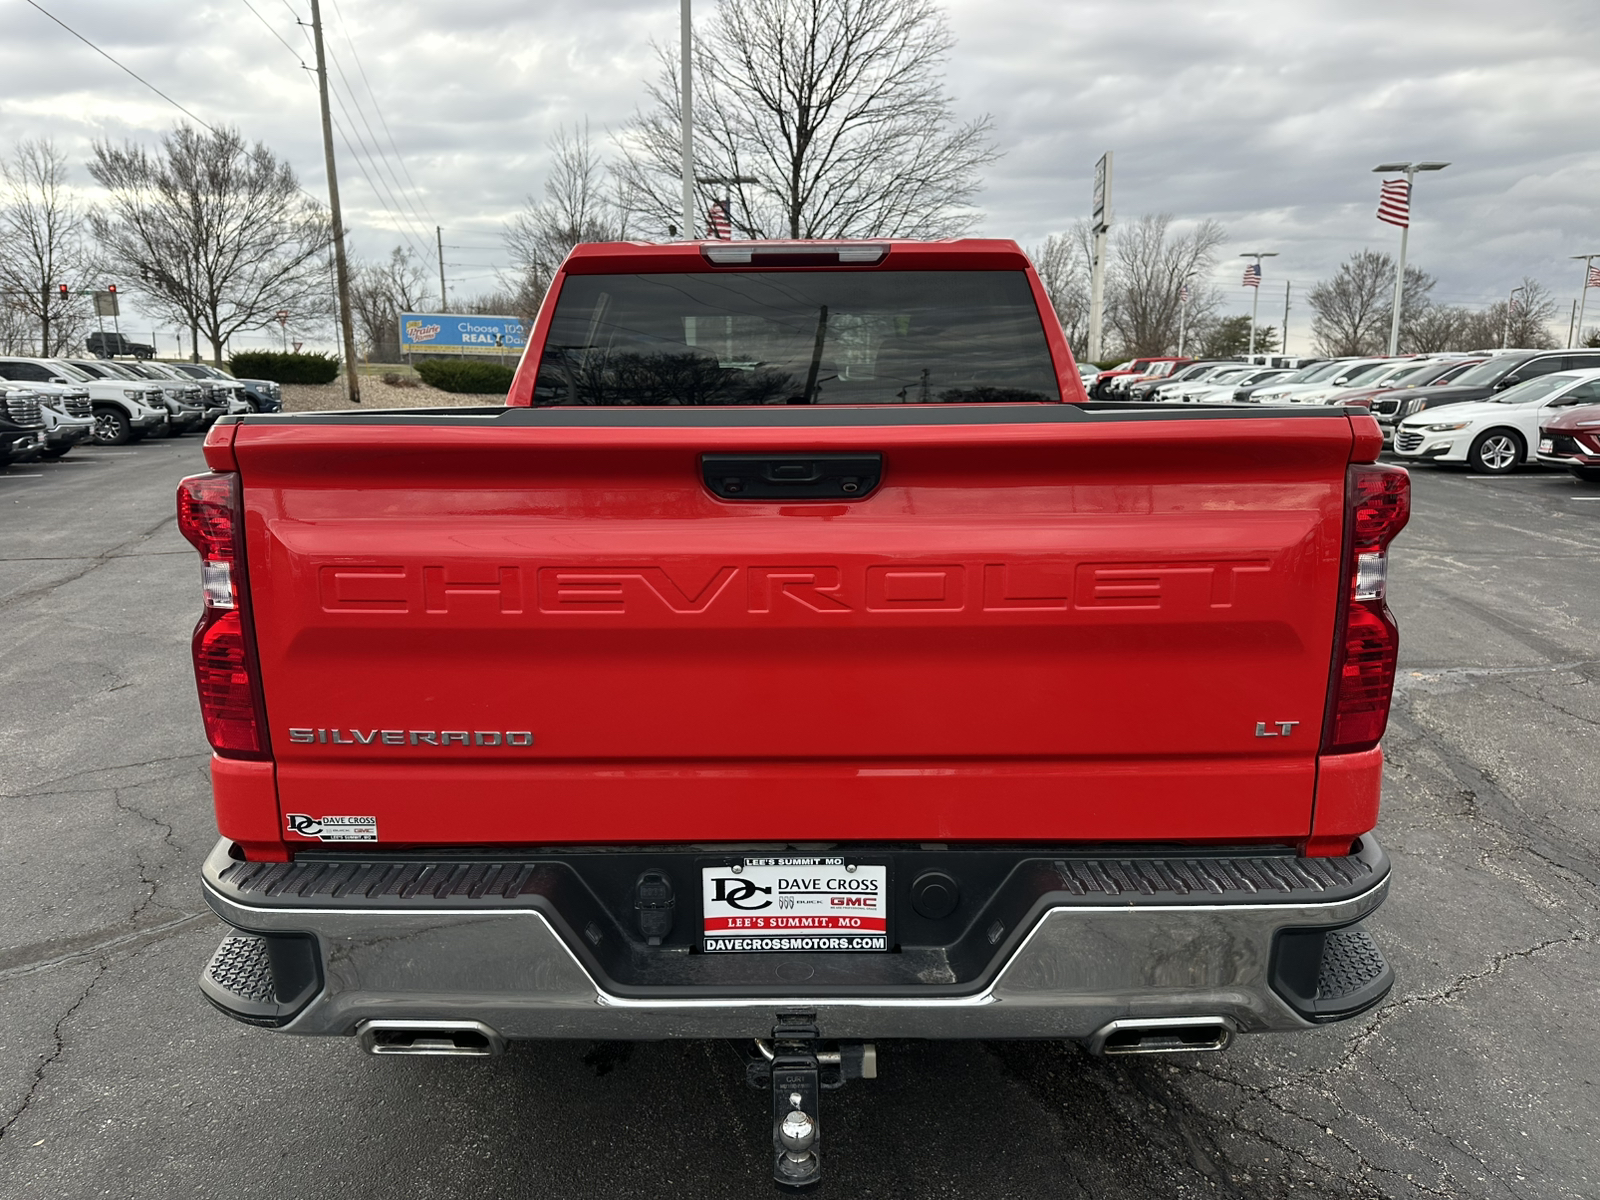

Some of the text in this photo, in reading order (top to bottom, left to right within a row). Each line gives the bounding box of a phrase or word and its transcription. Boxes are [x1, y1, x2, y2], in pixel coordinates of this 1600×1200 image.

[408, 324, 440, 337] Prairie
[458, 323, 498, 332] Choose
[462, 333, 493, 343] REAL
[318, 558, 1270, 615] CHEVROLET
[1255, 721, 1300, 737] LT
[289, 728, 534, 746] SILVERADO
[746, 858, 776, 866] LEE'S
[778, 858, 820, 866] SUMMIT
[778, 879, 878, 891] DAVE CROSS
[830, 897, 877, 907] GMC
[728, 918, 861, 928] LEE'S SUMMIT, MO
[706, 938, 885, 950] DAVECROSSMOTORS.COM
